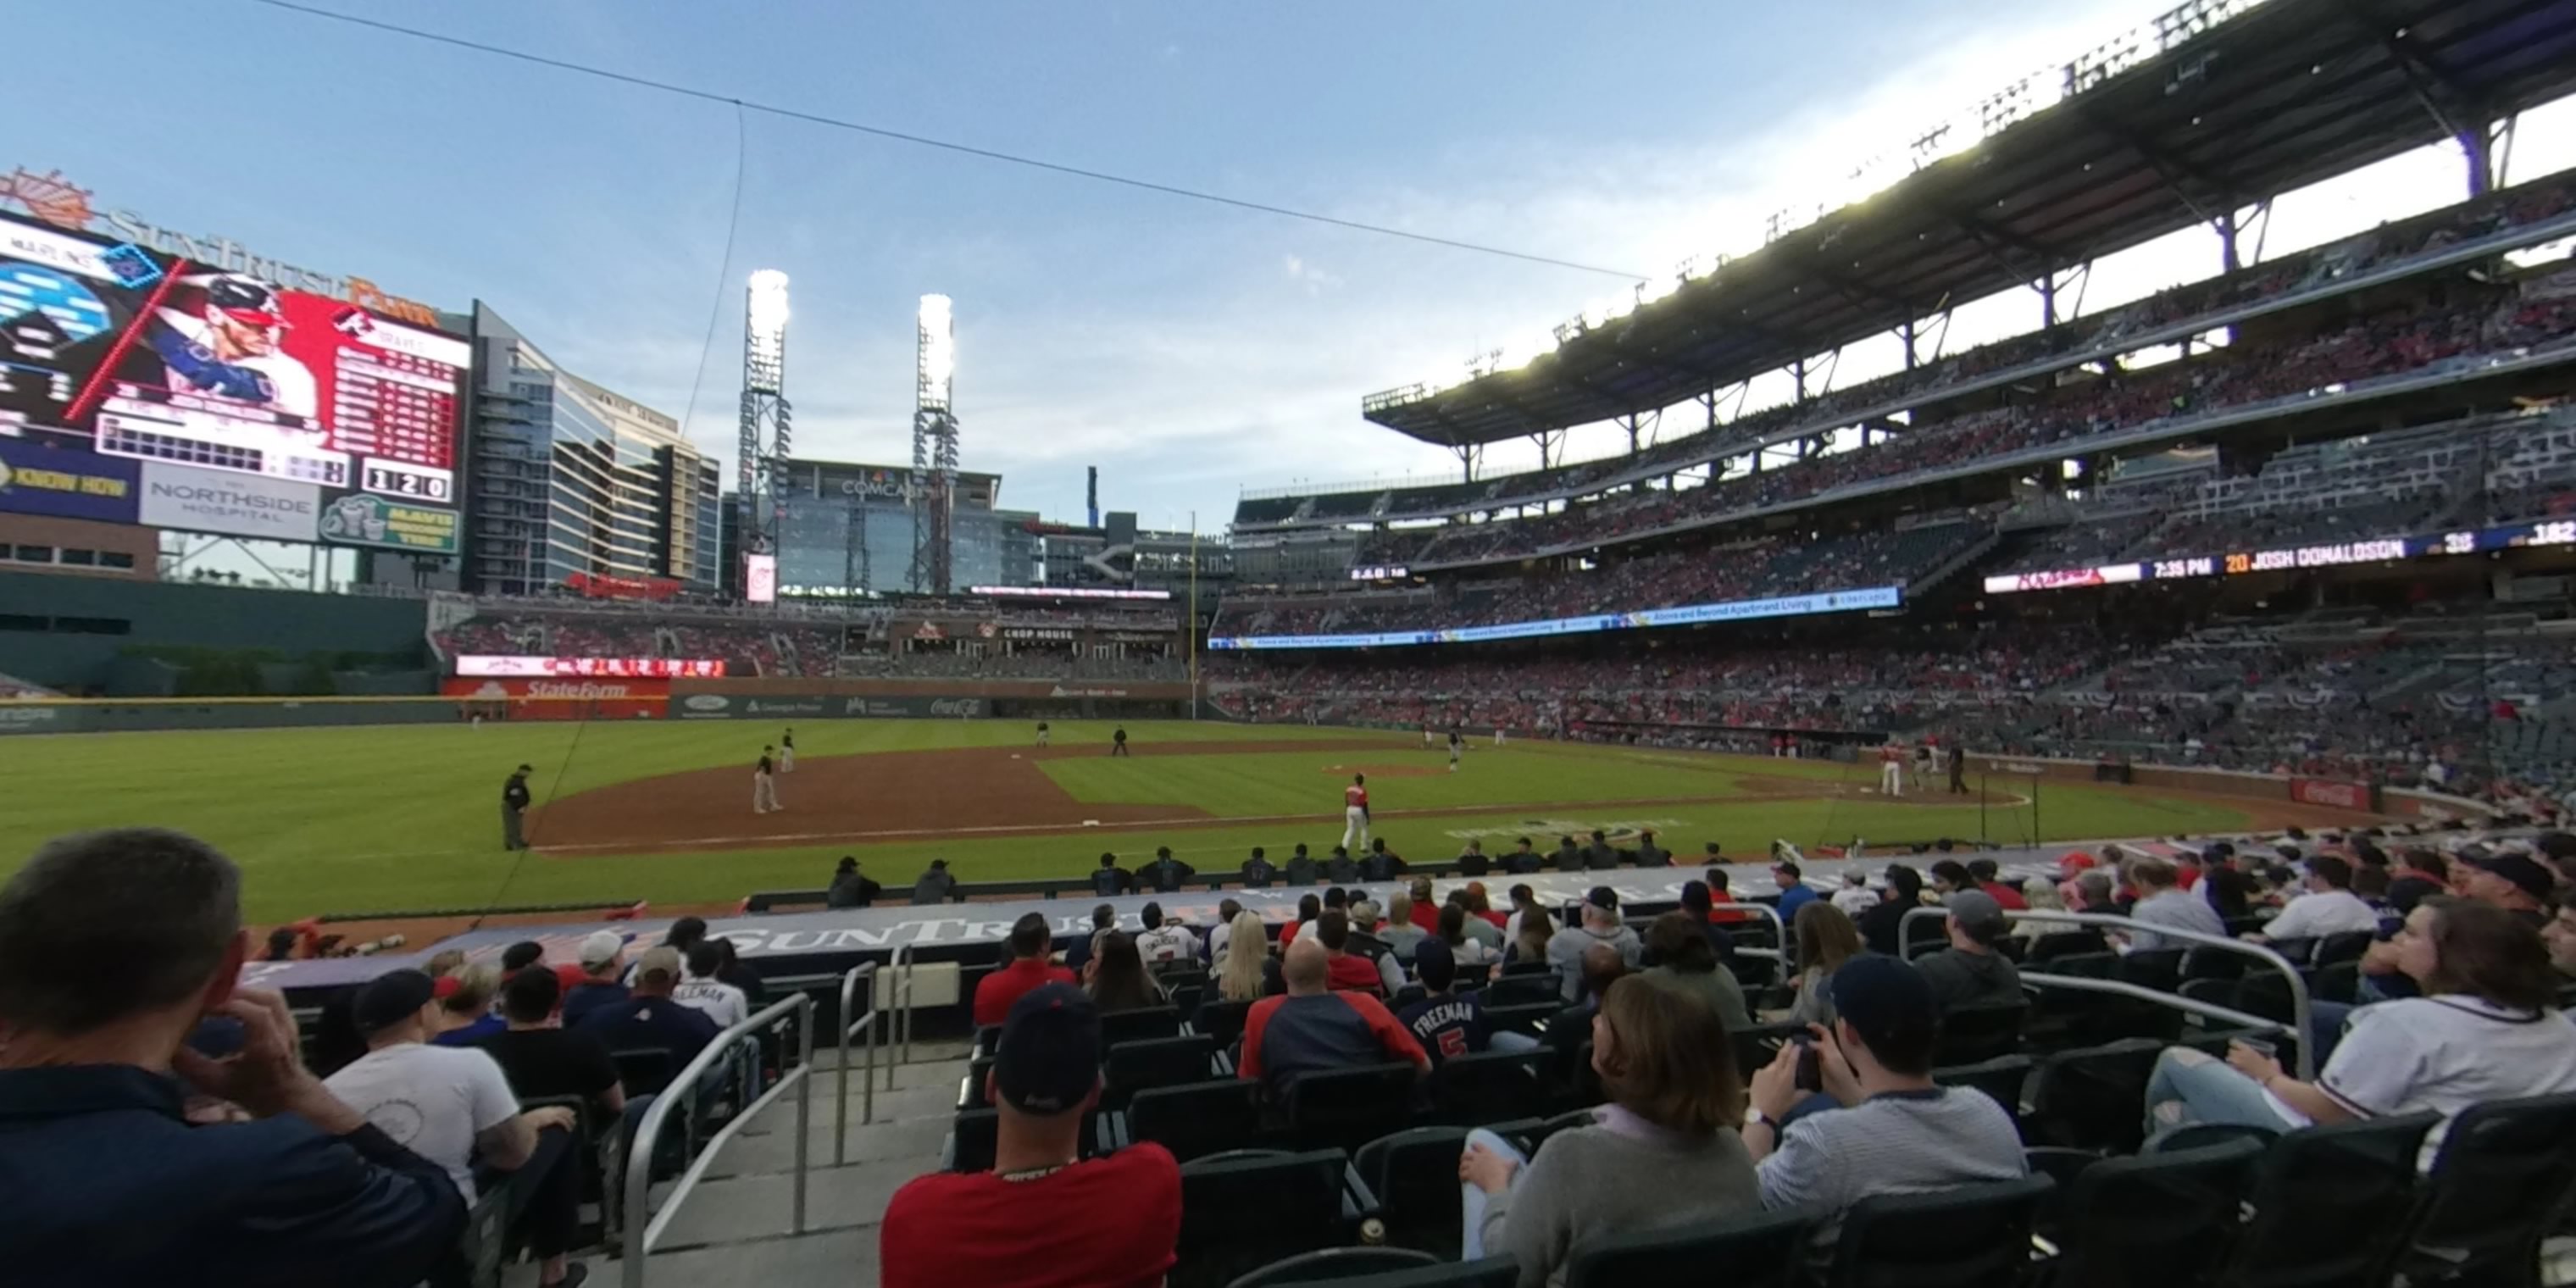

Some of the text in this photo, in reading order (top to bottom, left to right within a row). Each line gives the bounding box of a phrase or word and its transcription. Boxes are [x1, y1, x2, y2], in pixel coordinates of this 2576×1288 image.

[374, 469, 444, 497] 1 2 0
[151, 481, 313, 514] NORTHSIDE
[182, 503, 285, 523] HOSPITAL
[2154, 558, 2212, 578] 7:35 PM
[2225, 553, 2248, 573] 20
[2251, 549, 2295, 570] JOSH
[2297, 539, 2406, 567] DONALDSON
[1781, 598, 1813, 612] Living
[1003, 629, 1073, 640] CHOP HOUSE
[679, 985, 726, 1004] EEMAN
[1413, 1001, 1474, 1039] FREEMAN
[1437, 1025, 1469, 1058] 5
